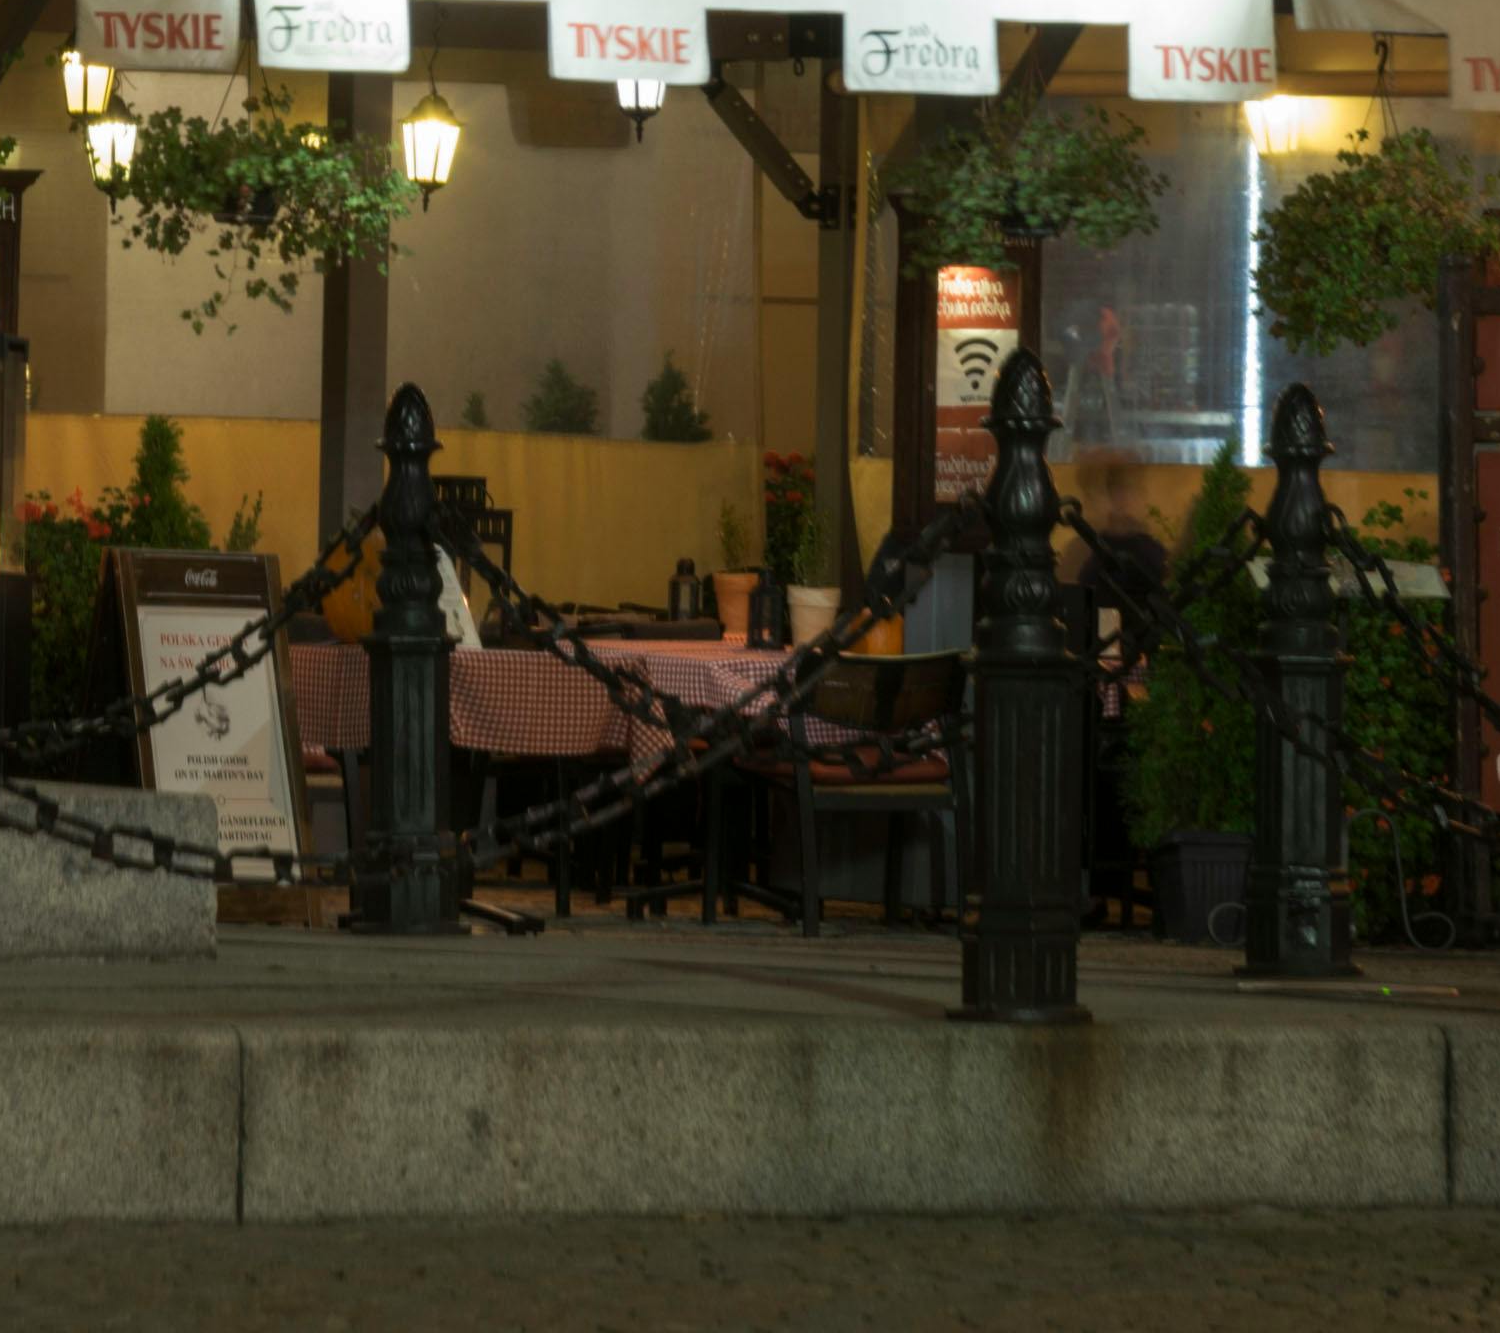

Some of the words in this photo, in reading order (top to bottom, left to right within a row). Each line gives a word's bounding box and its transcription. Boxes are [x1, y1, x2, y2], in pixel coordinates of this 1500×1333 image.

[94, 11, 224, 51] TYSKIE
[567, 22, 691, 65] TYSKIE
[1154, 45, 1274, 84] TYSKIE
[160, 632, 204, 646] POLSKA
[186, 755, 218, 766] POLISH
